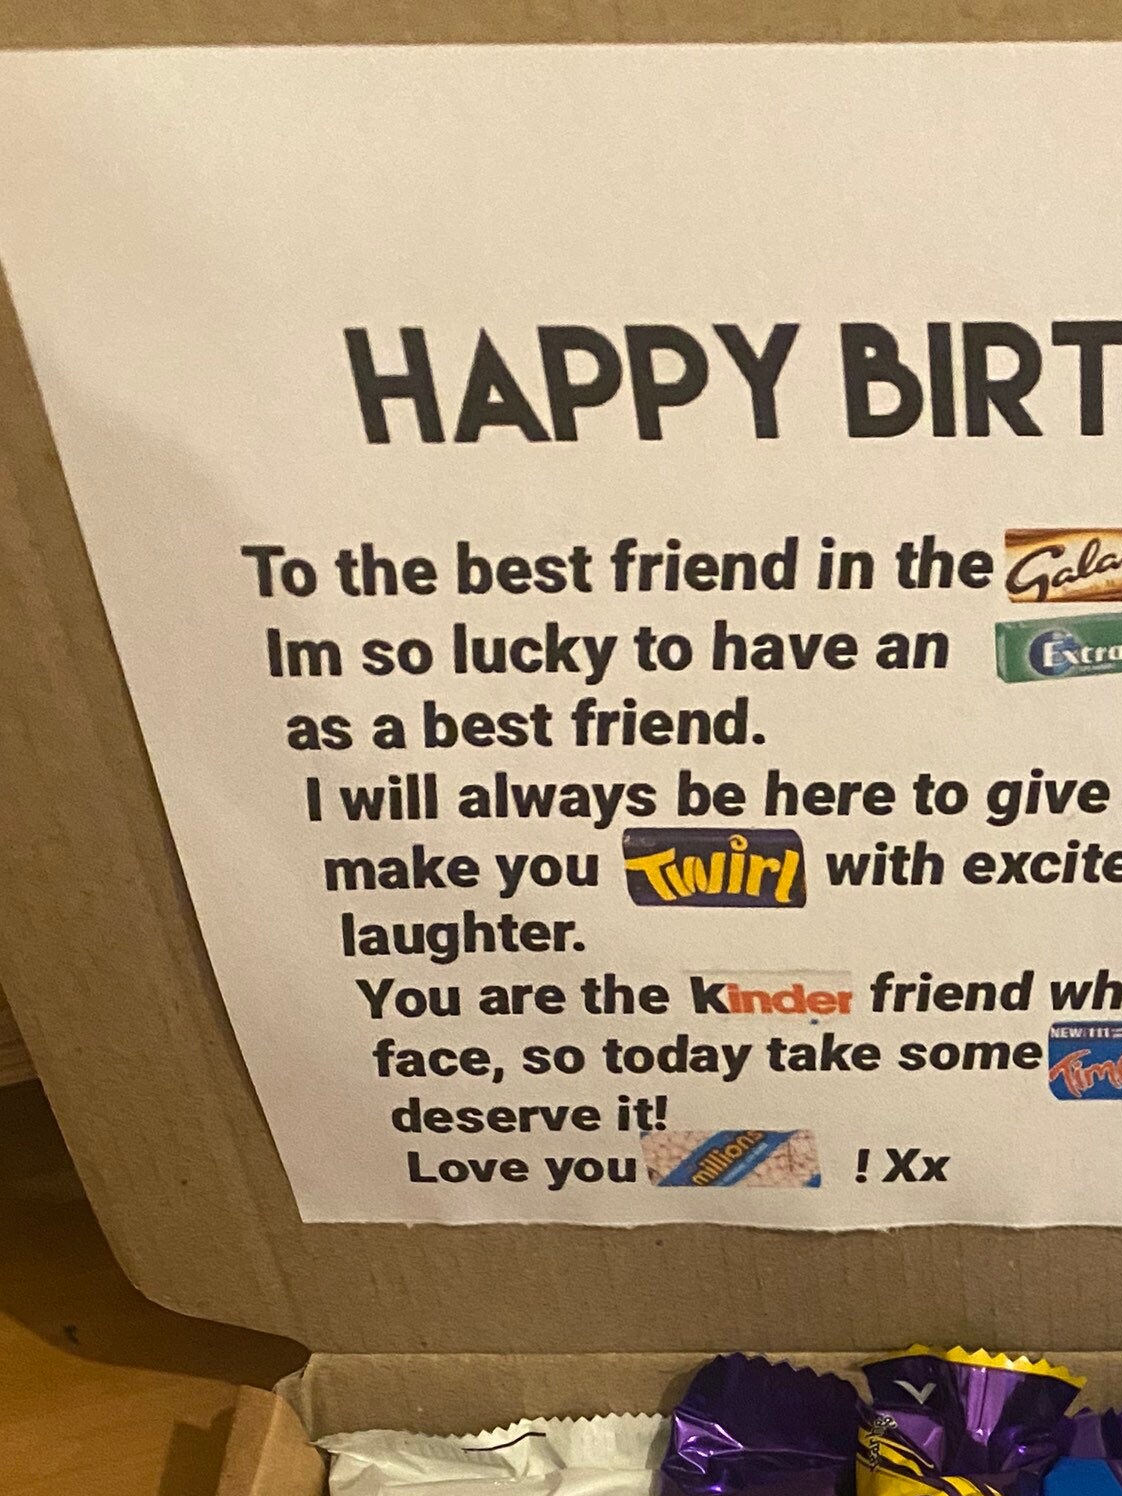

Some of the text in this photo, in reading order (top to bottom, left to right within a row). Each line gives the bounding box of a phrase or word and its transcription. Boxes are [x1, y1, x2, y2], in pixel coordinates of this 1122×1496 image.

[345, 324, 799, 443] HAPPY
[242, 546, 316, 597] To
[335, 543, 437, 596] the
[458, 542, 592, 594] best
[611, 537, 798, 591] friend
[818, 537, 873, 589] in
[896, 535, 993, 588] the
[268, 629, 341, 677] Im
[363, 640, 432, 675] so
[454, 623, 617, 685] lucky
[634, 627, 692, 671] to
[713, 620, 857, 670] have
[877, 633, 948, 669] an
[287, 697, 765, 750] as a best friend.
[307, 778, 321, 821] I
[340, 773, 437, 820] will
[459, 772, 656, 829] always
[678, 770, 745, 816] be
[766, 770, 895, 815] here
[913, 774, 968, 815] to
[987, 769, 1109, 826] give
[325, 845, 479, 891] make
[496, 855, 598, 898] you
[624, 833, 800, 903] Twirl
[827, 841, 943, 885] with
[342, 910, 585, 964] laughter.
[356, 979, 460, 1019] You
[480, 985, 565, 1015] are
[581, 974, 669, 1014] the
[871, 971, 1034, 1012] friend
[373, 1039, 503, 1083] face,
[523, 1046, 584, 1074] so
[603, 1034, 752, 1082] today
[767, 1033, 880, 1071] take
[899, 1040, 1042, 1071] some
[392, 1095, 667, 1133] deserve it!
[408, 1151, 528, 1183] Love
[547, 1153, 637, 1192] you
[882, 1149, 950, 1182] Xx
